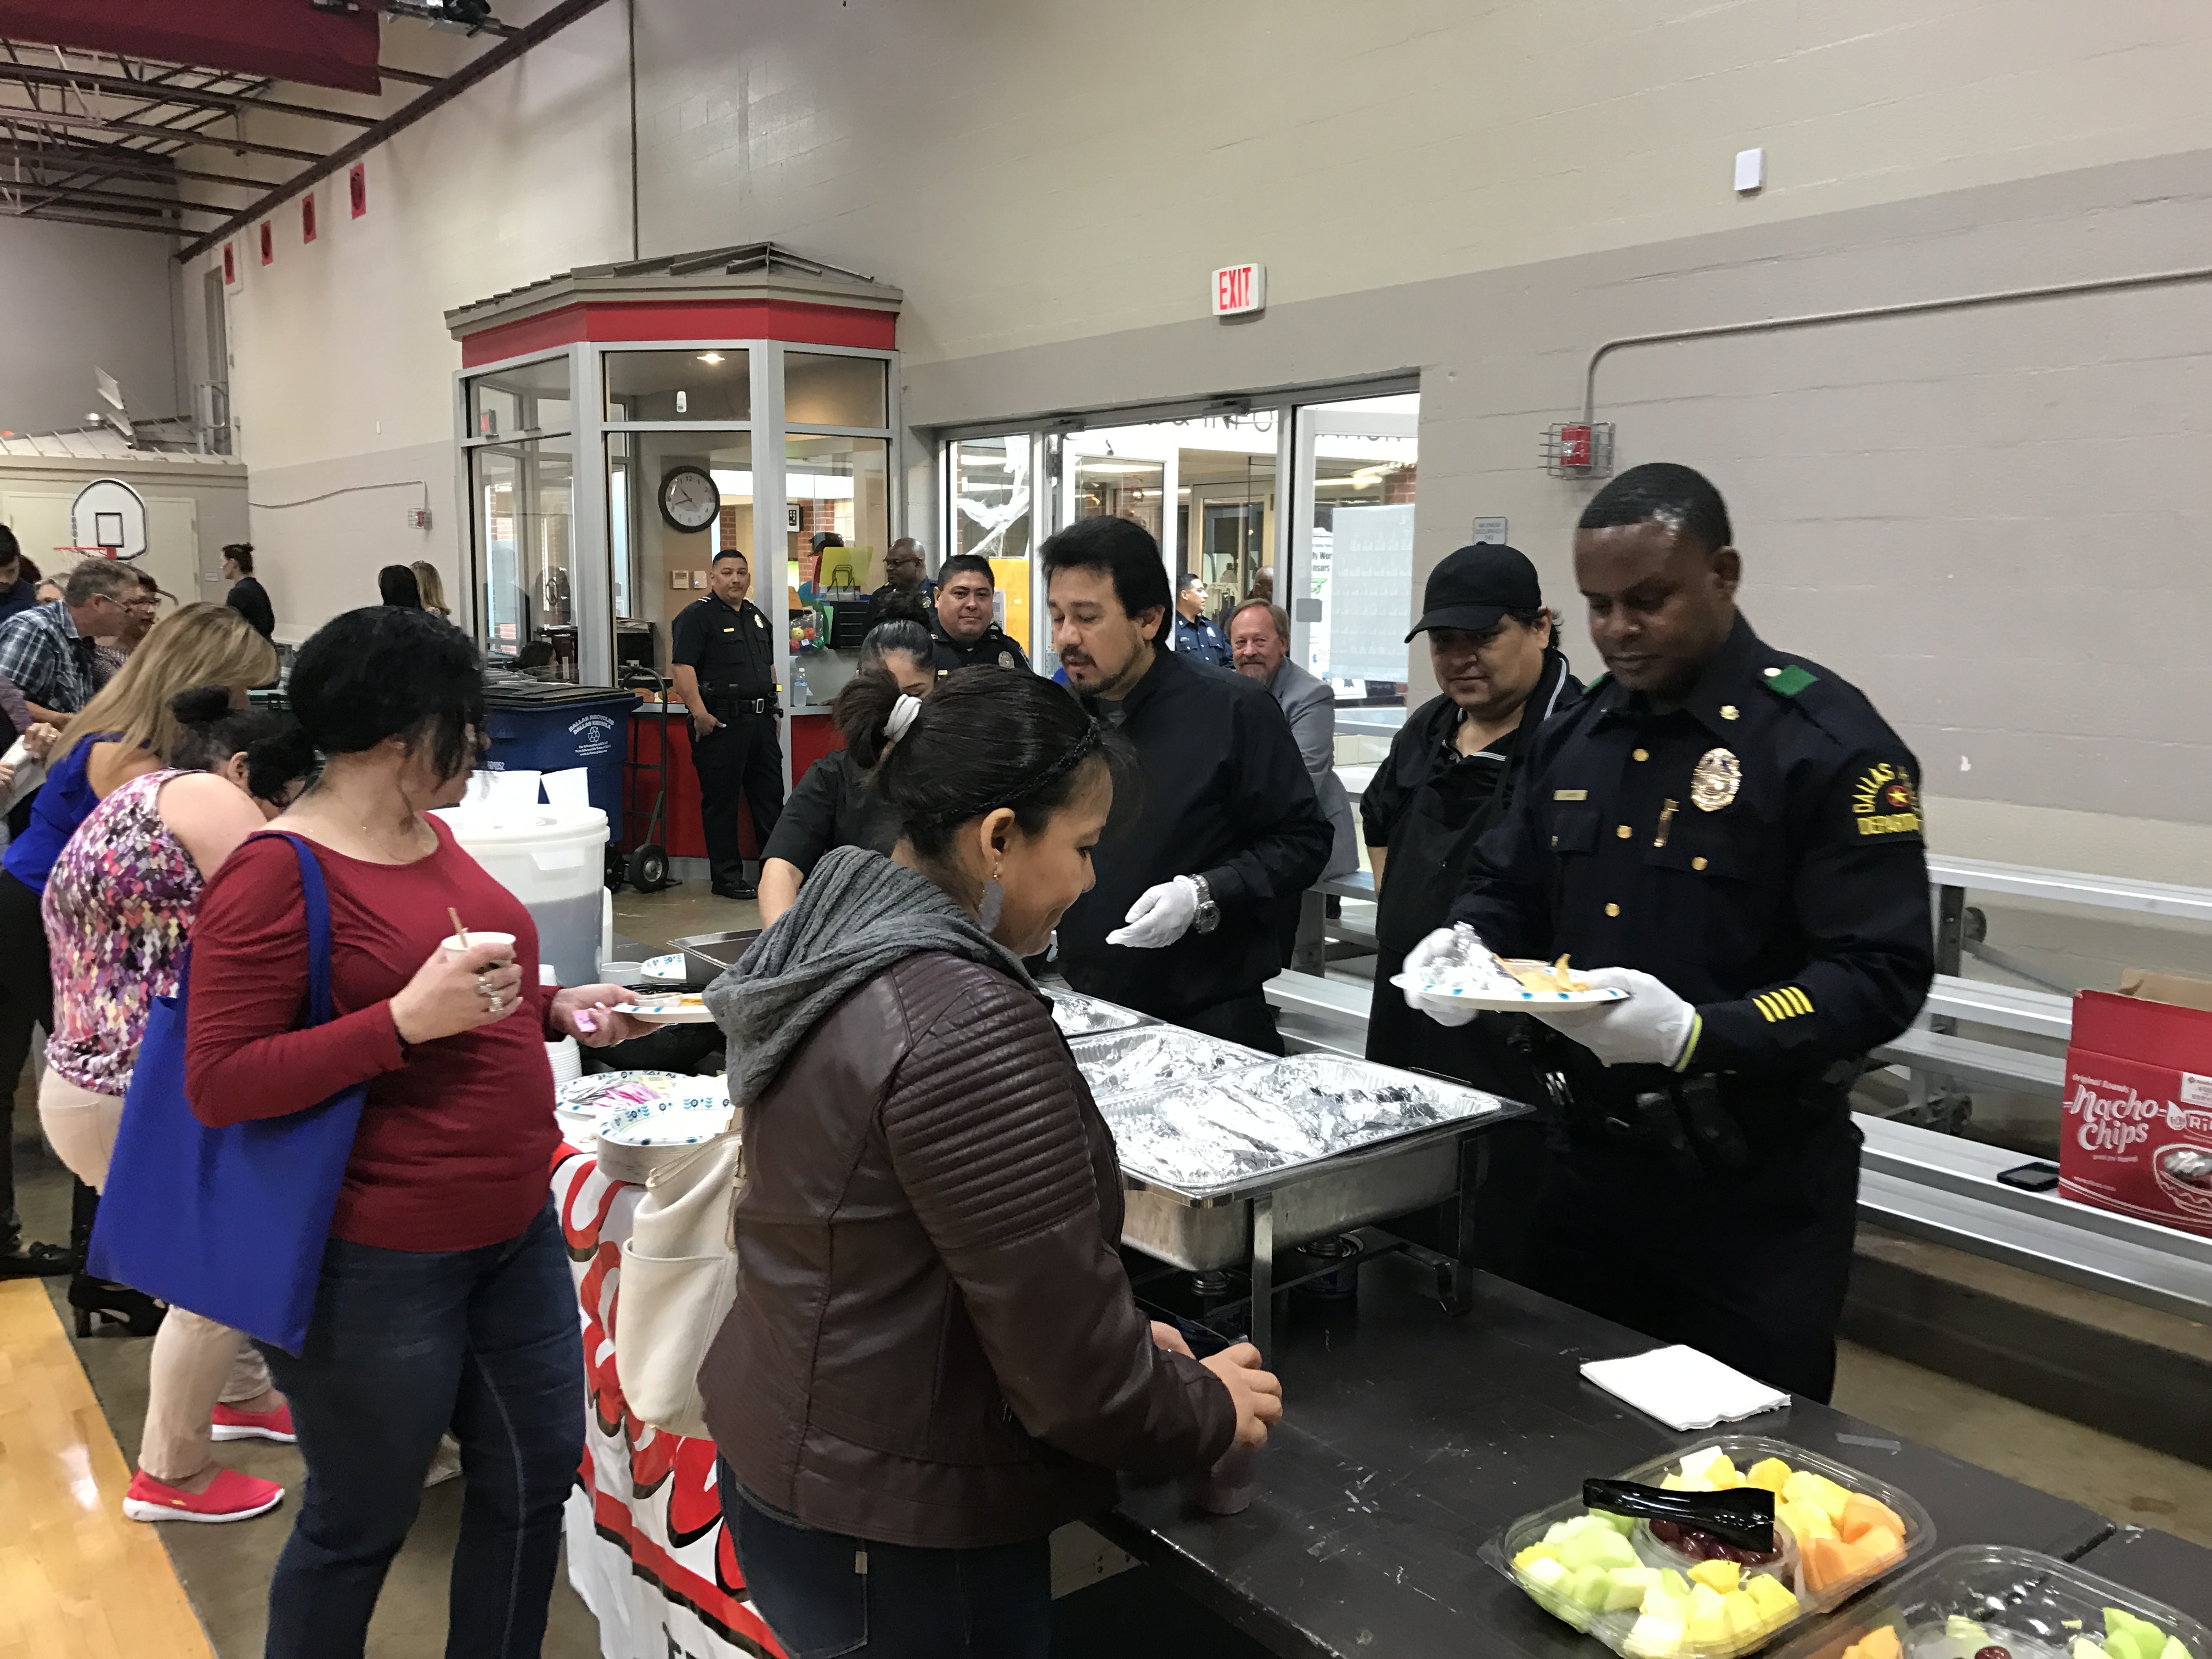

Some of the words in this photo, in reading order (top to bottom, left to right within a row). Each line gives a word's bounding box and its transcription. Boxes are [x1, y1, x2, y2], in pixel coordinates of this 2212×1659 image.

[1219, 267, 1251, 310] EXIT
[568, 716, 589, 732] DALLAS
[573, 721, 591, 735] DALLAS
[1852, 763, 1895, 813] DALLAS
[2078, 1119, 2149, 1154] Chips
[2190, 1115, 2212, 1132] Ri
